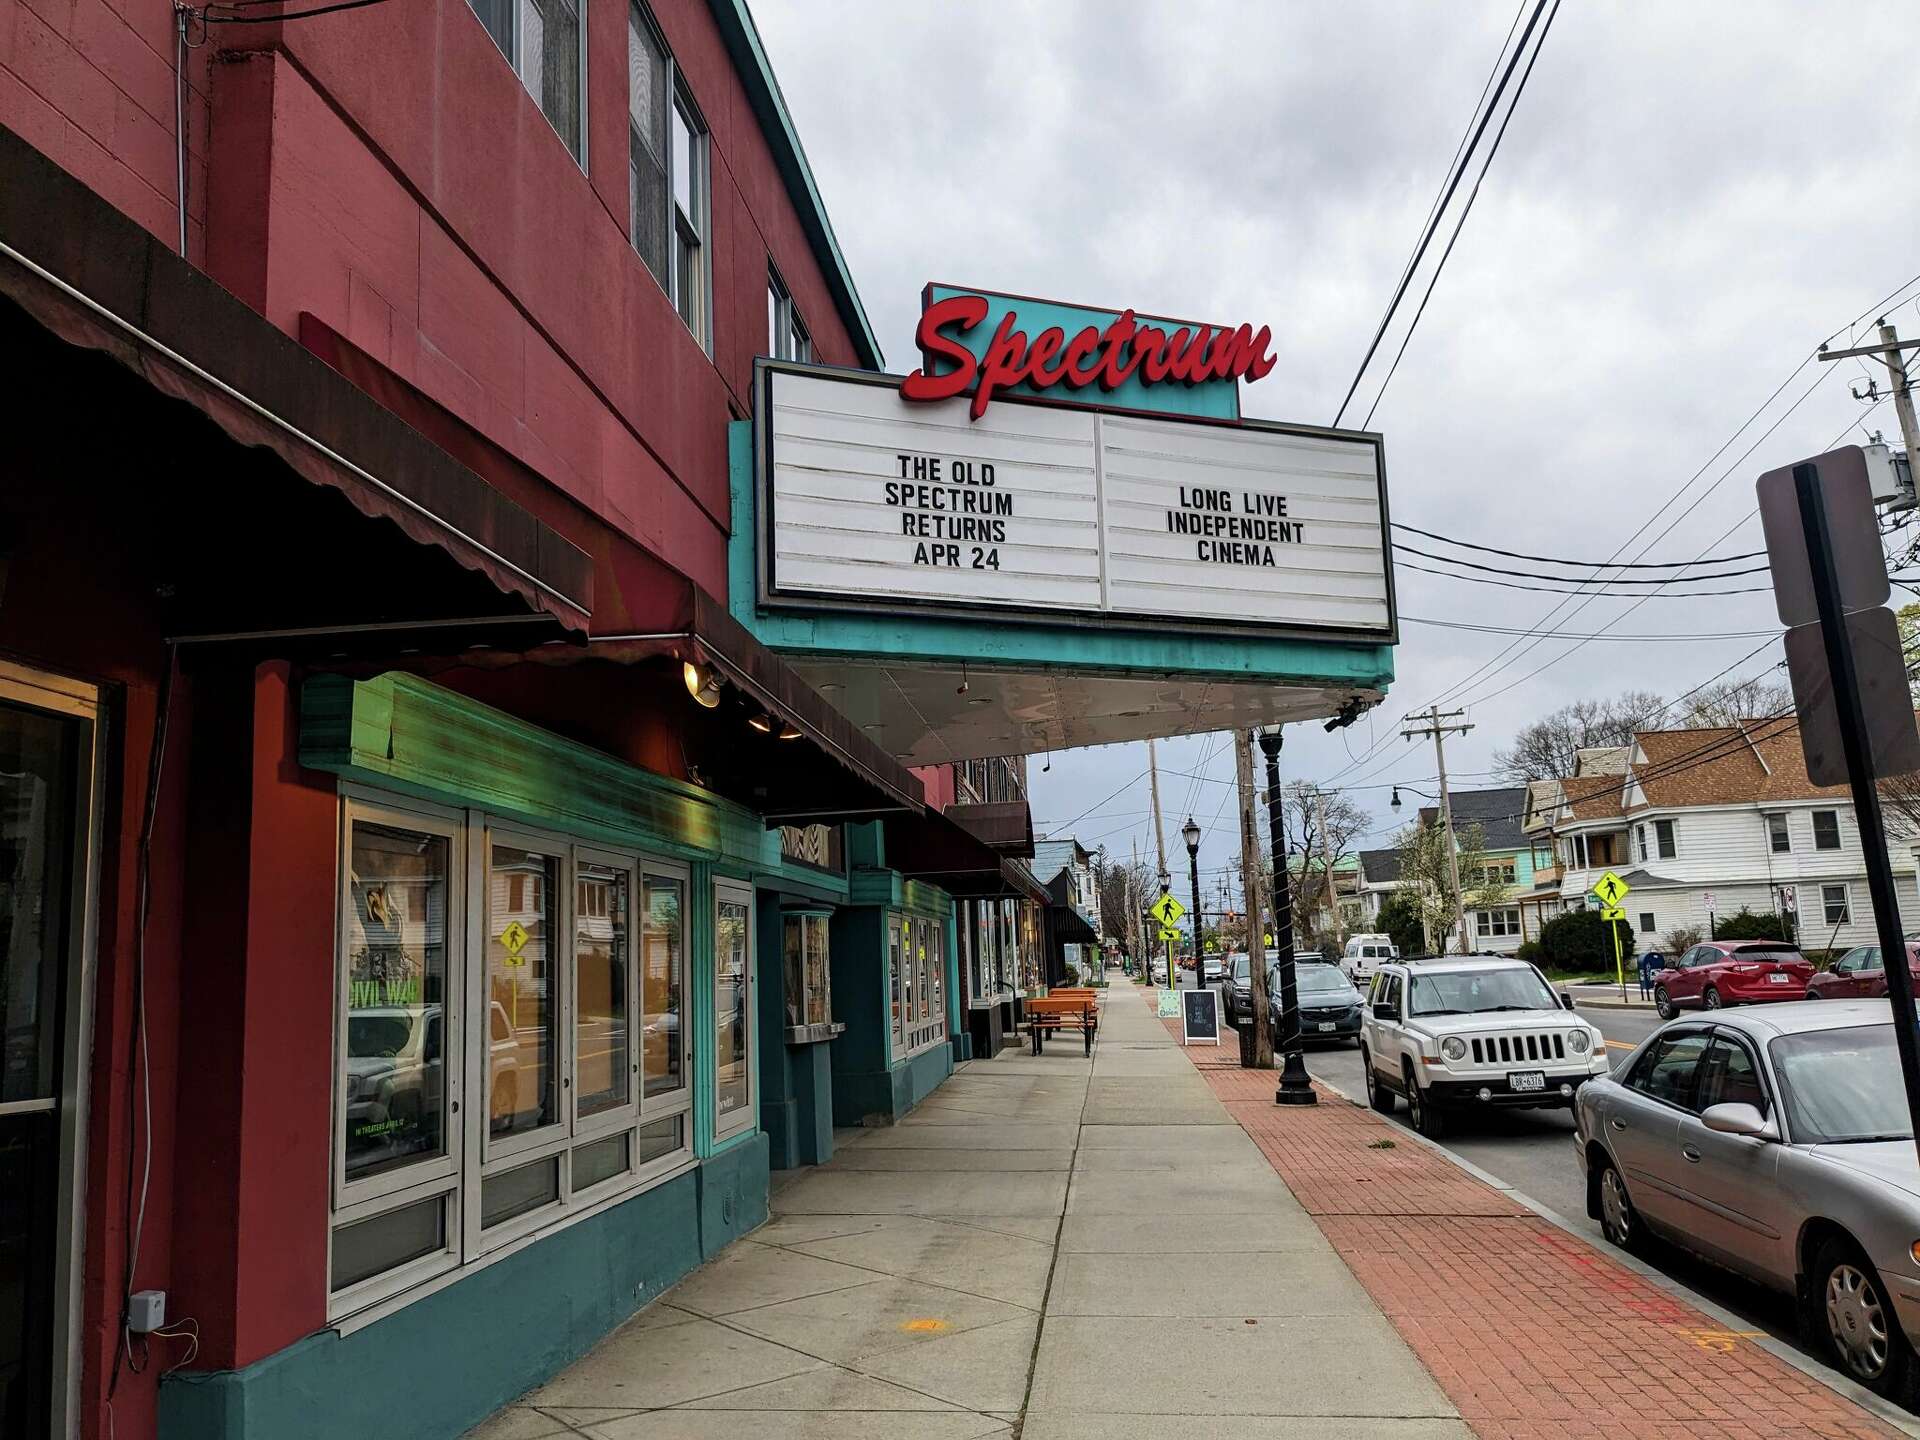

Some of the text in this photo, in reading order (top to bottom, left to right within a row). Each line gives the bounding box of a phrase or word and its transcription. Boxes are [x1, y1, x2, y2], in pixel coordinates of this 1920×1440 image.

[900, 296, 1278, 421] Spectrum
[897, 455, 995, 486] THE OLD
[885, 482, 1013, 516] SPECTRUM
[1179, 486, 1288, 517] LONG LIVE
[902, 512, 1006, 542] RETURNS
[1167, 511, 1304, 544] INDEPENDENT
[914, 542, 1000, 570] APR 24
[1197, 540, 1276, 566] CINEMA
